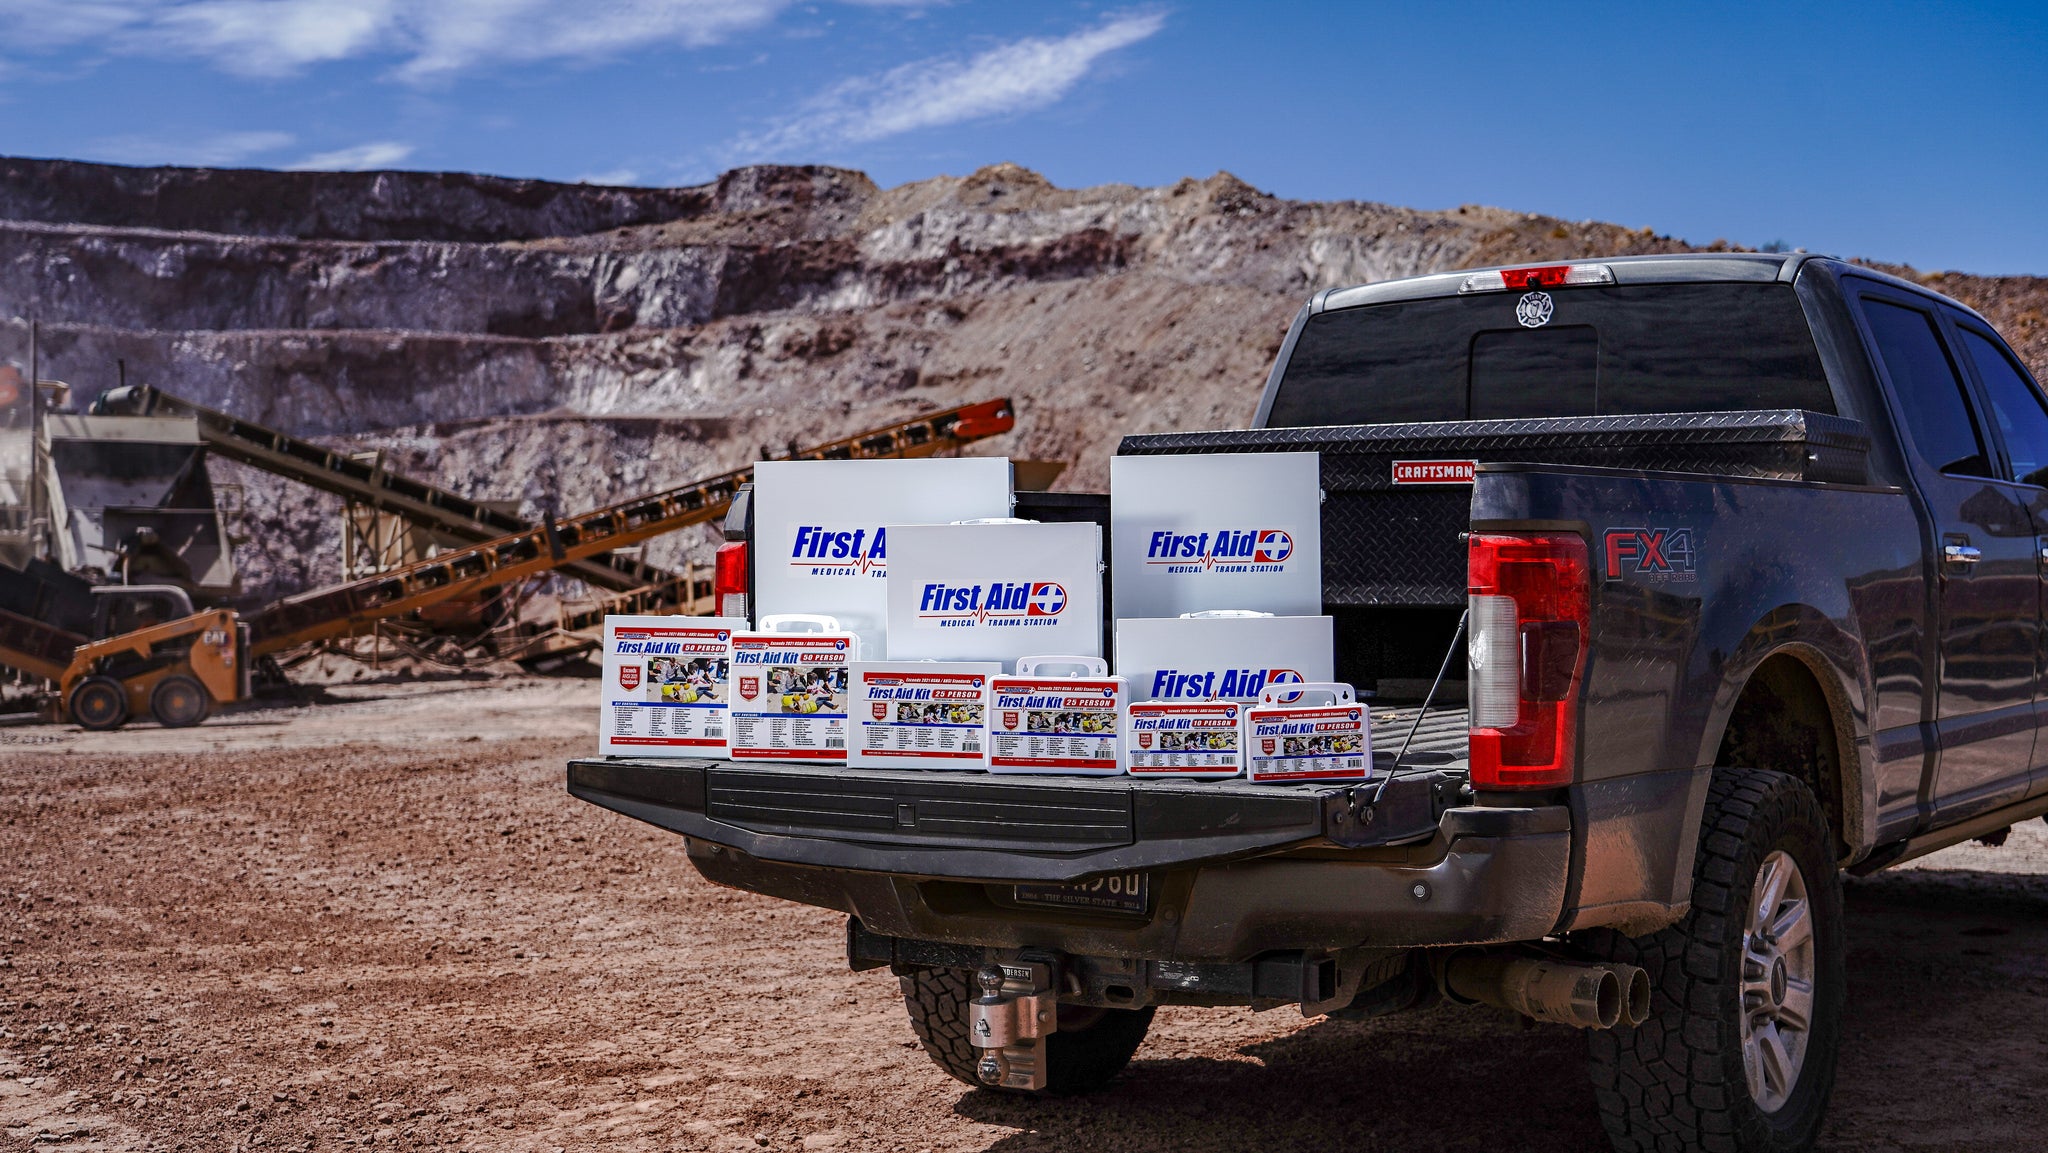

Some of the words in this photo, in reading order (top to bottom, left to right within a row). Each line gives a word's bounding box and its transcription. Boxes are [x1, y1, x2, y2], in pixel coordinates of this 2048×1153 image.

[1398, 466, 1472, 478] CRAFTSMAN
[792, 526, 866, 558] First
[1148, 531, 1209, 558] First
[1211, 530, 1258, 557] Aid
[1603, 527, 1696, 581] FX4
[811, 567, 856, 576] MEDICAL
[871, 570, 887, 578] TRA
[1215, 565, 1247, 573] TRAUMA
[920, 584, 981, 611] First
[984, 583, 1031, 610] Aid
[940, 619, 975, 627] MEDICAL
[1024, 618, 1058, 626] STATION
[203, 631, 226, 645] CAT
[617, 641, 643, 653] First
[643, 642, 664, 654] Aid
[664, 642, 681, 654] Kit
[735, 651, 761, 663] First
[762, 652, 782, 664] Aid
[782, 652, 799, 664] Kit
[1151, 669, 1215, 698] First
[1218, 669, 1267, 698] Aid
[868, 687, 894, 699] First
[895, 687, 914, 700] Aid
[915, 688, 931, 700] Kit
[998, 695, 1024, 707] First
[1025, 696, 1045, 708] Aid
[1045, 696, 1063, 708] Kit
[1134, 719, 1157, 729] First
[1158, 719, 1176, 729] Aid
[1176, 719, 1191, 729] Kit
[1256, 724, 1280, 736] First
[1281, 723, 1298, 735] Aid
[1299, 723, 1314, 734] Kit
[1044, 893, 1061, 902] THE
[1062, 895, 1090, 905] SILVER
[1092, 898, 1116, 907] STATE
[1002, 968, 1030, 978] NDERSEN
